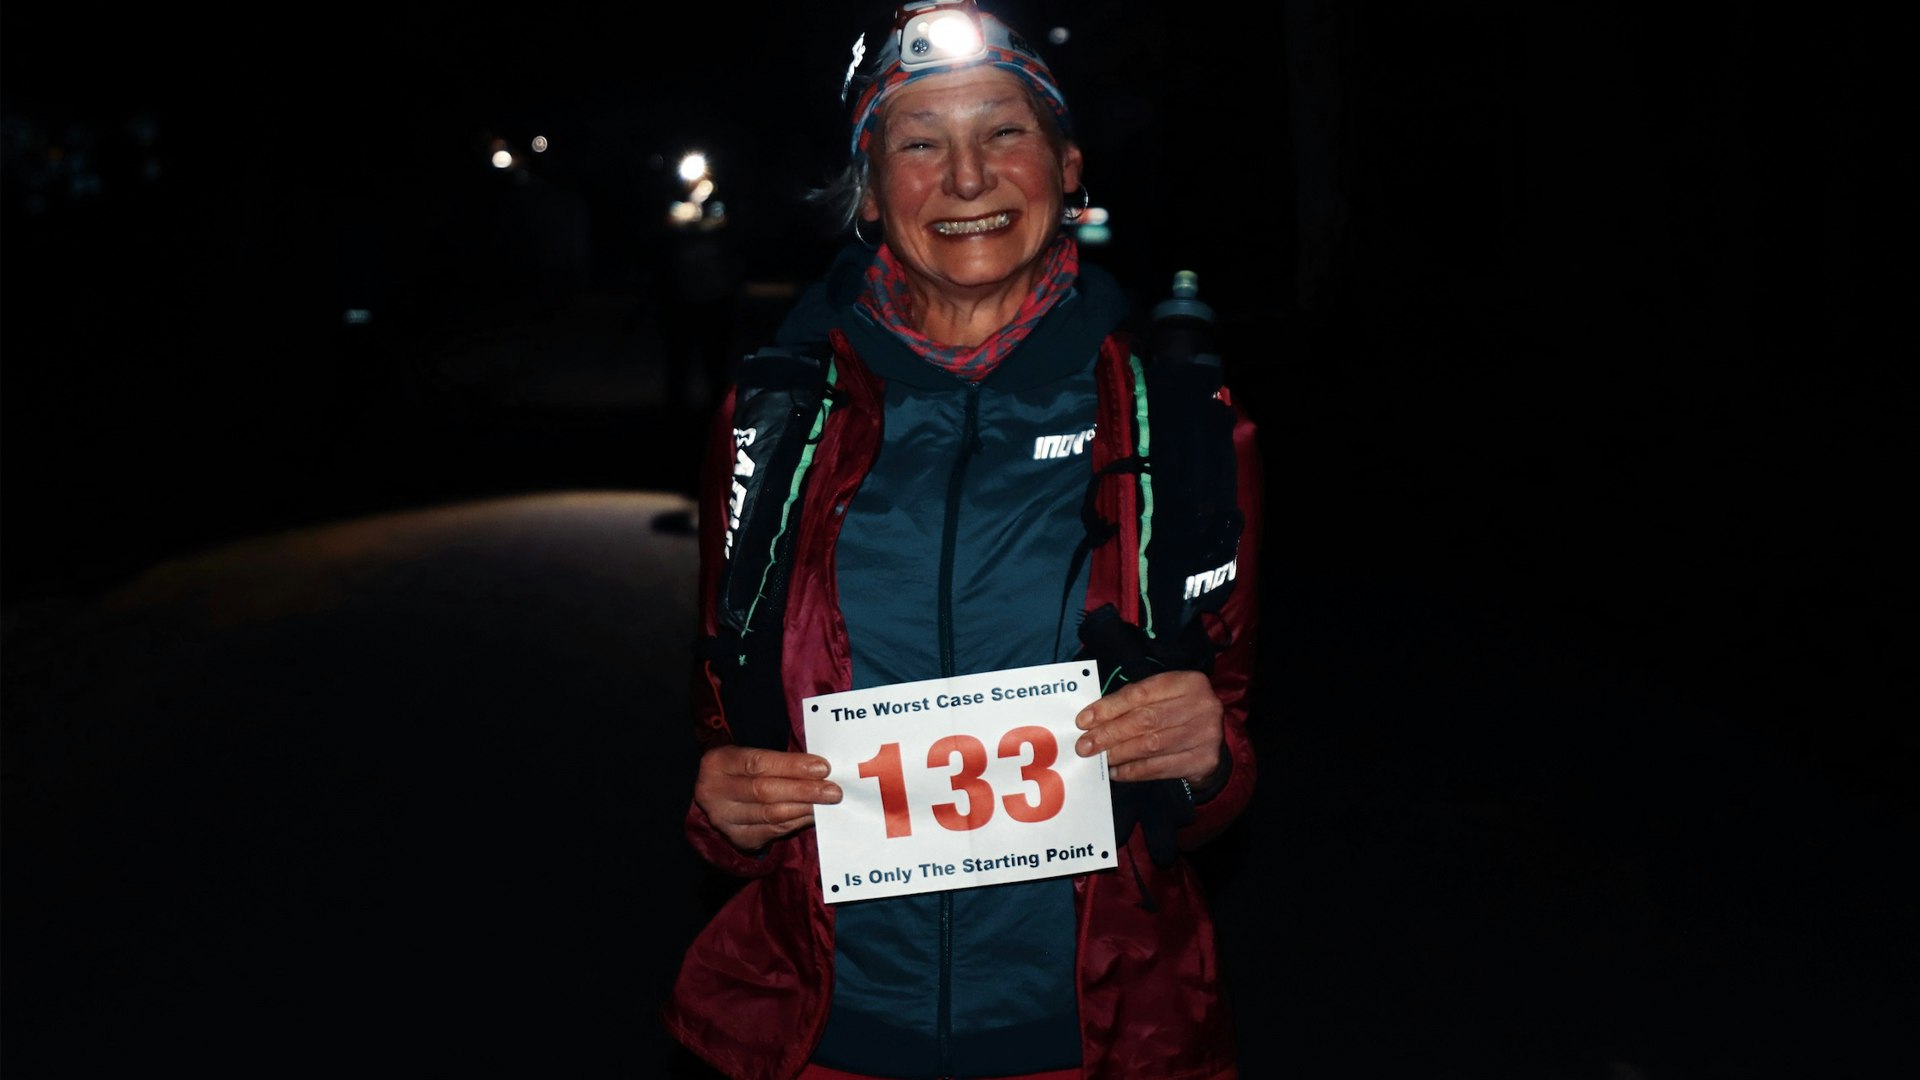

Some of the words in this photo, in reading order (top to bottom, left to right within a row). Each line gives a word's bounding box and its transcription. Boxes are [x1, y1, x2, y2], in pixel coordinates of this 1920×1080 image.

[830, 707, 867, 722] The
[872, 697, 930, 717] Worst
[936, 692, 984, 709] Case
[990, 679, 1079, 701] Scenario
[857, 725, 1065, 839] 133
[844, 872, 862, 887] Is
[868, 867, 912, 885] Only
[918, 862, 956, 878] The
[962, 853, 1040, 874] Starting
[1045, 842, 1095, 863] Point
